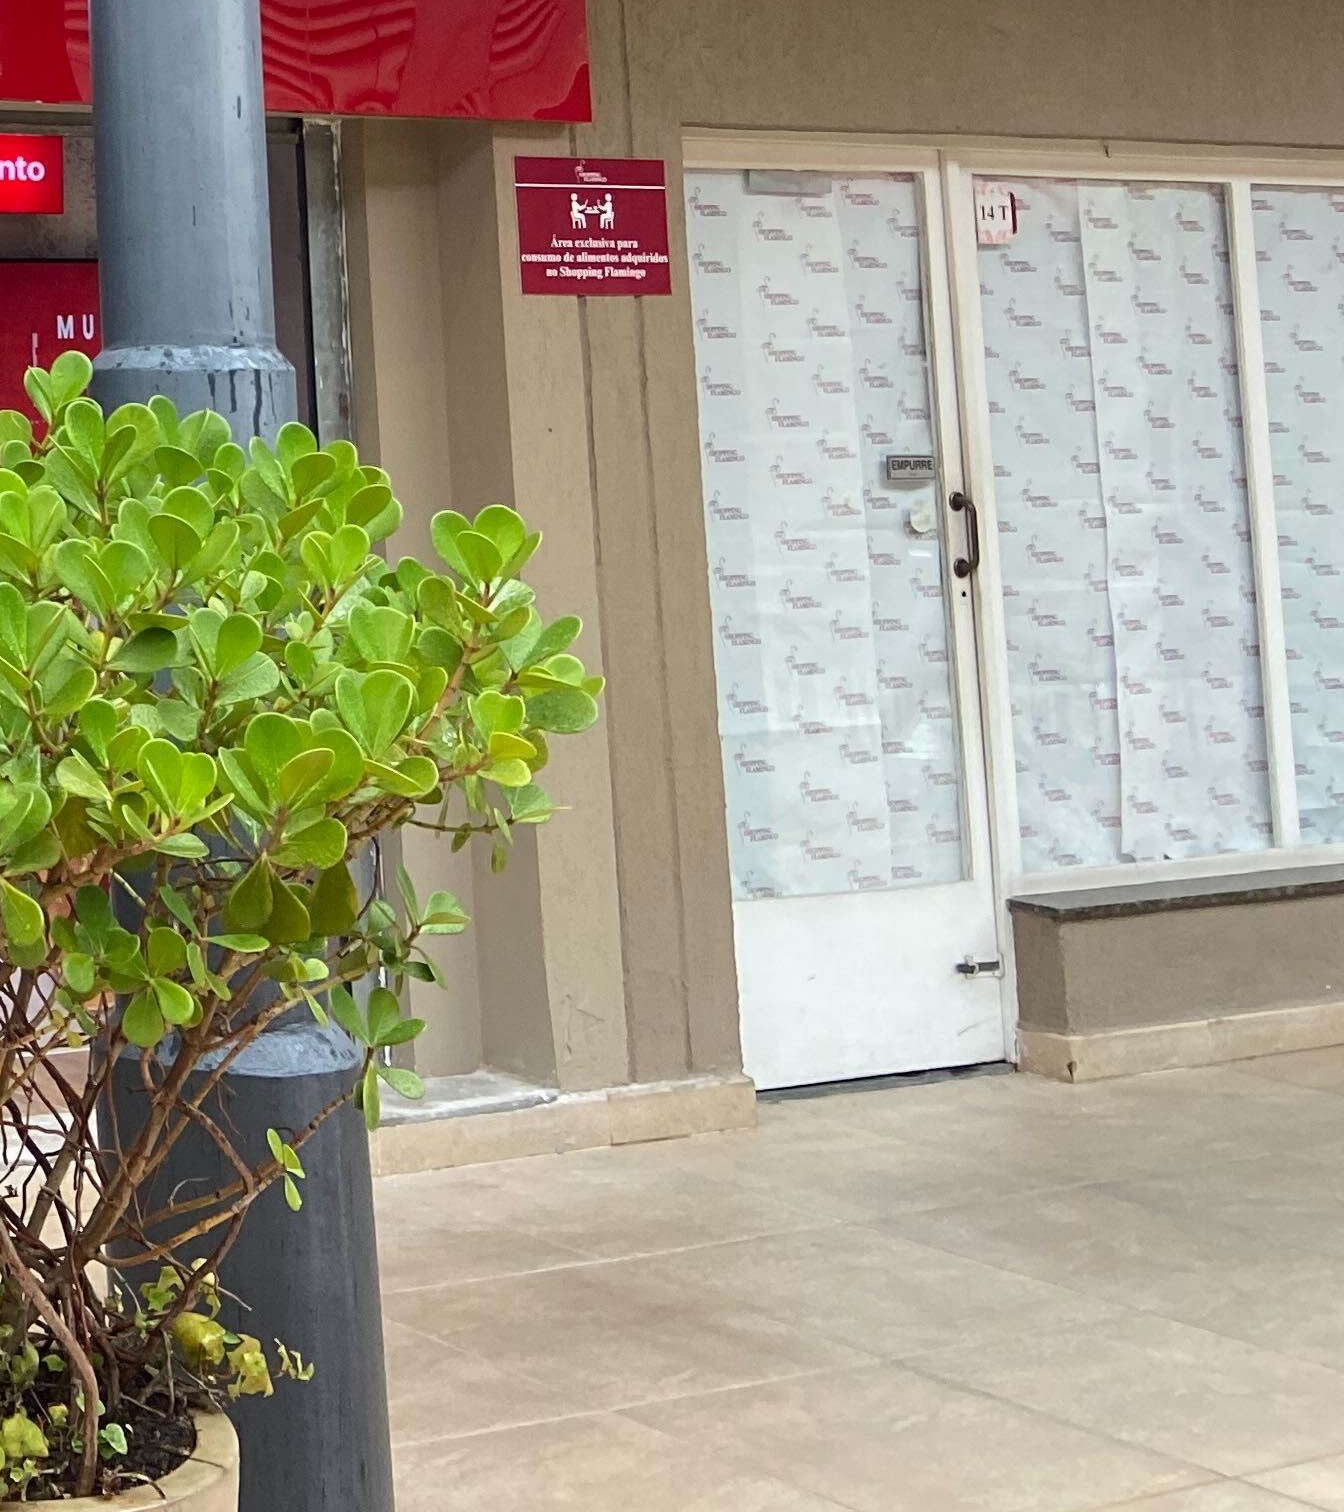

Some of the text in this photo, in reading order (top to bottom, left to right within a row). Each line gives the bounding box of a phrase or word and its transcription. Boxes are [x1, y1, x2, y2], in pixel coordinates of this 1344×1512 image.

[980, 205, 1009, 221] 14 T
[550, 234, 638, 251] Área exclusiva para
[521, 252, 669, 266] consumo de alimentos adquiridos
[545, 266, 646, 279] no Shopping Flamingo
[56, 313, 95, 340] MU
[891, 459, 933, 471] EMPURRE
